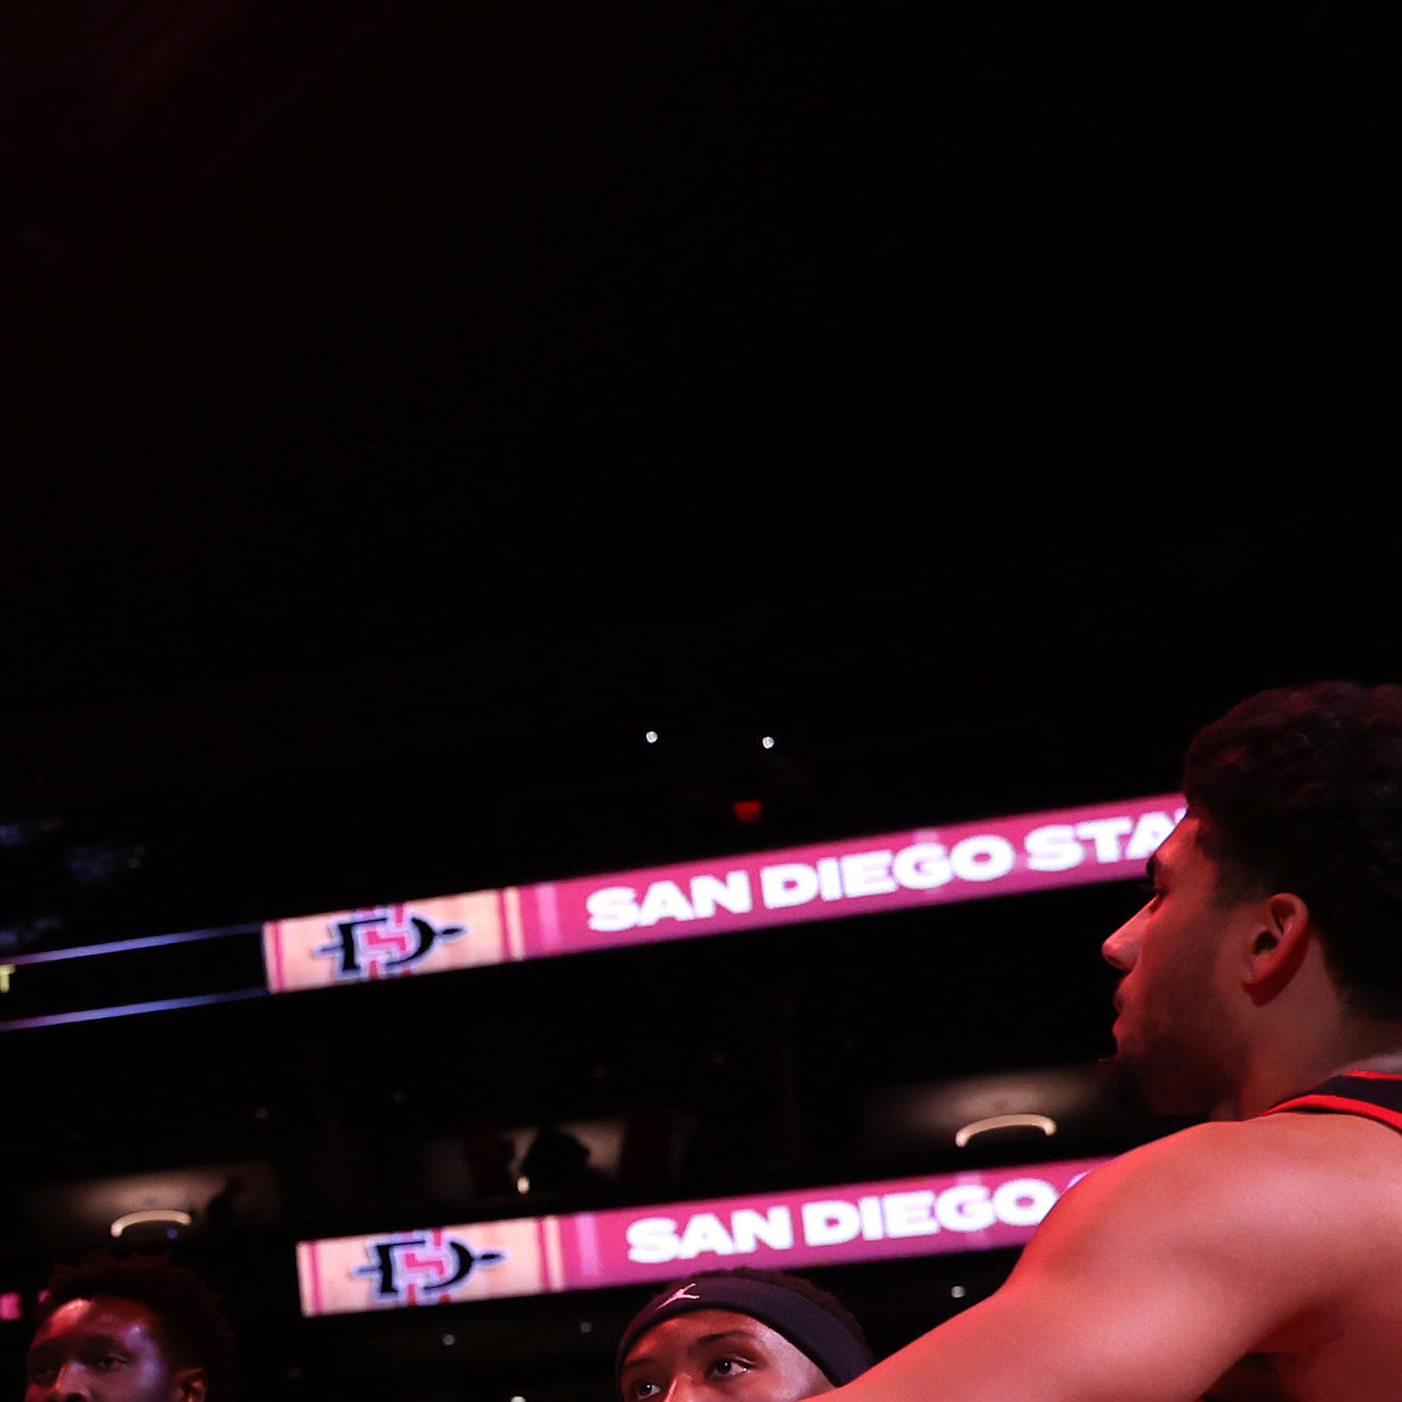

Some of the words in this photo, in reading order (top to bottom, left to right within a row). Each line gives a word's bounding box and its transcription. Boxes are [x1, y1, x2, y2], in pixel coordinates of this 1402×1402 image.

[587, 869, 752, 931] SAN
[760, 835, 1014, 910] DIEGO
[1024, 808, 1186, 872] STA
[625, 1205, 793, 1263] SAN
[801, 1178, 1059, 1247] DIEGO
